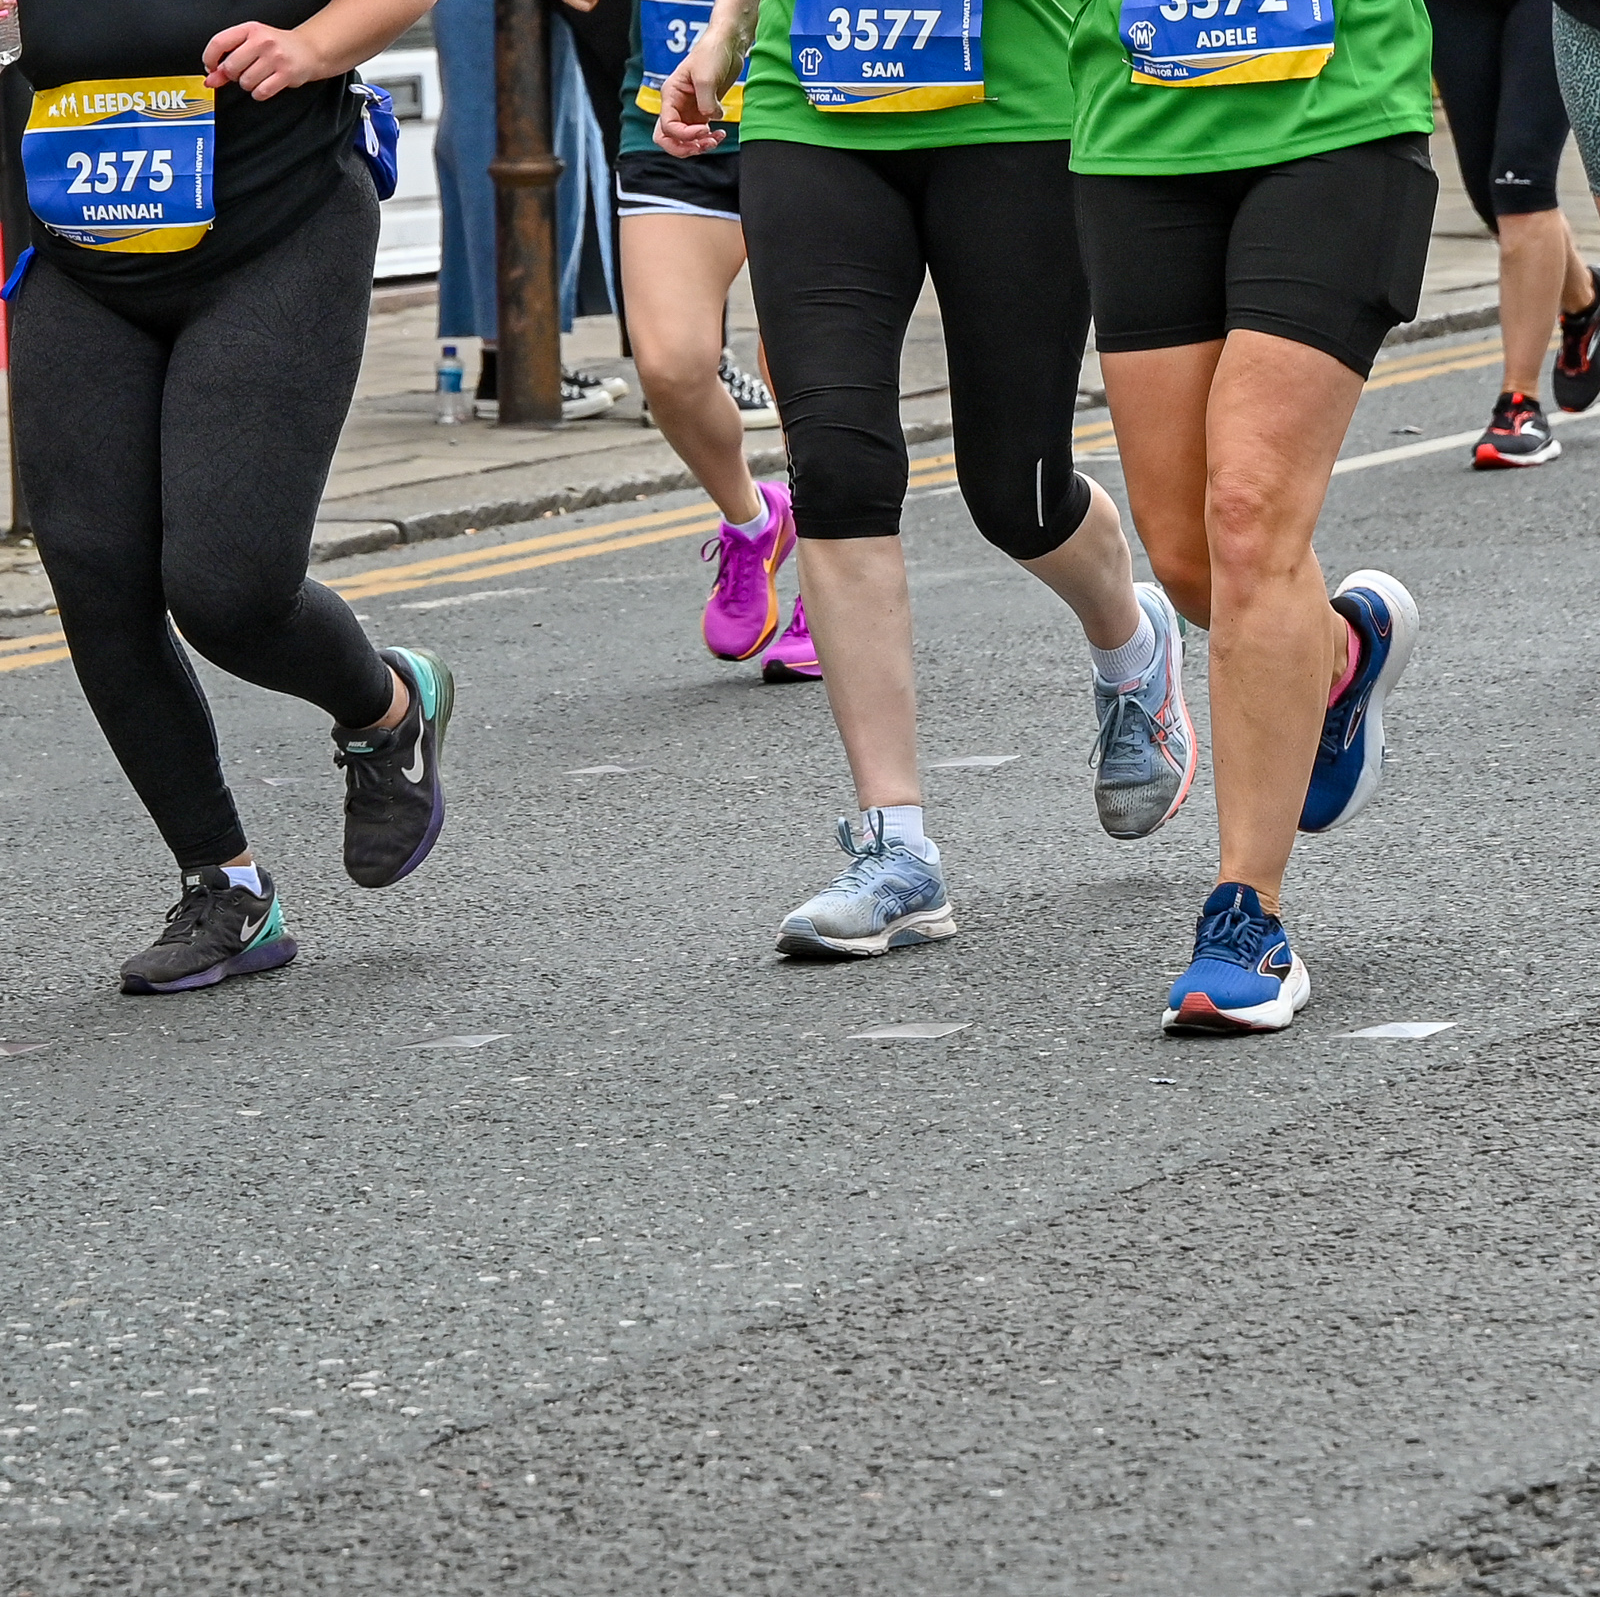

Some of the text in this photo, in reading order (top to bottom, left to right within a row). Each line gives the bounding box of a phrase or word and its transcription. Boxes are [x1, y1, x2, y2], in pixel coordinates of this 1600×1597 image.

[826, 7, 942, 51] 3577
[1137, 26, 1257, 49] M ADELE
[807, 54, 905, 78] L SAM
[1173, 66, 1189, 77] ALL
[83, 89, 188, 114] LEEDS 10K
[816, 93, 846, 102] FOR ALL
[66, 137, 204, 209] 2575 NEWTON HANNAH
[82, 202, 163, 221] HANNAH
[83, 235, 96, 243] ALL
